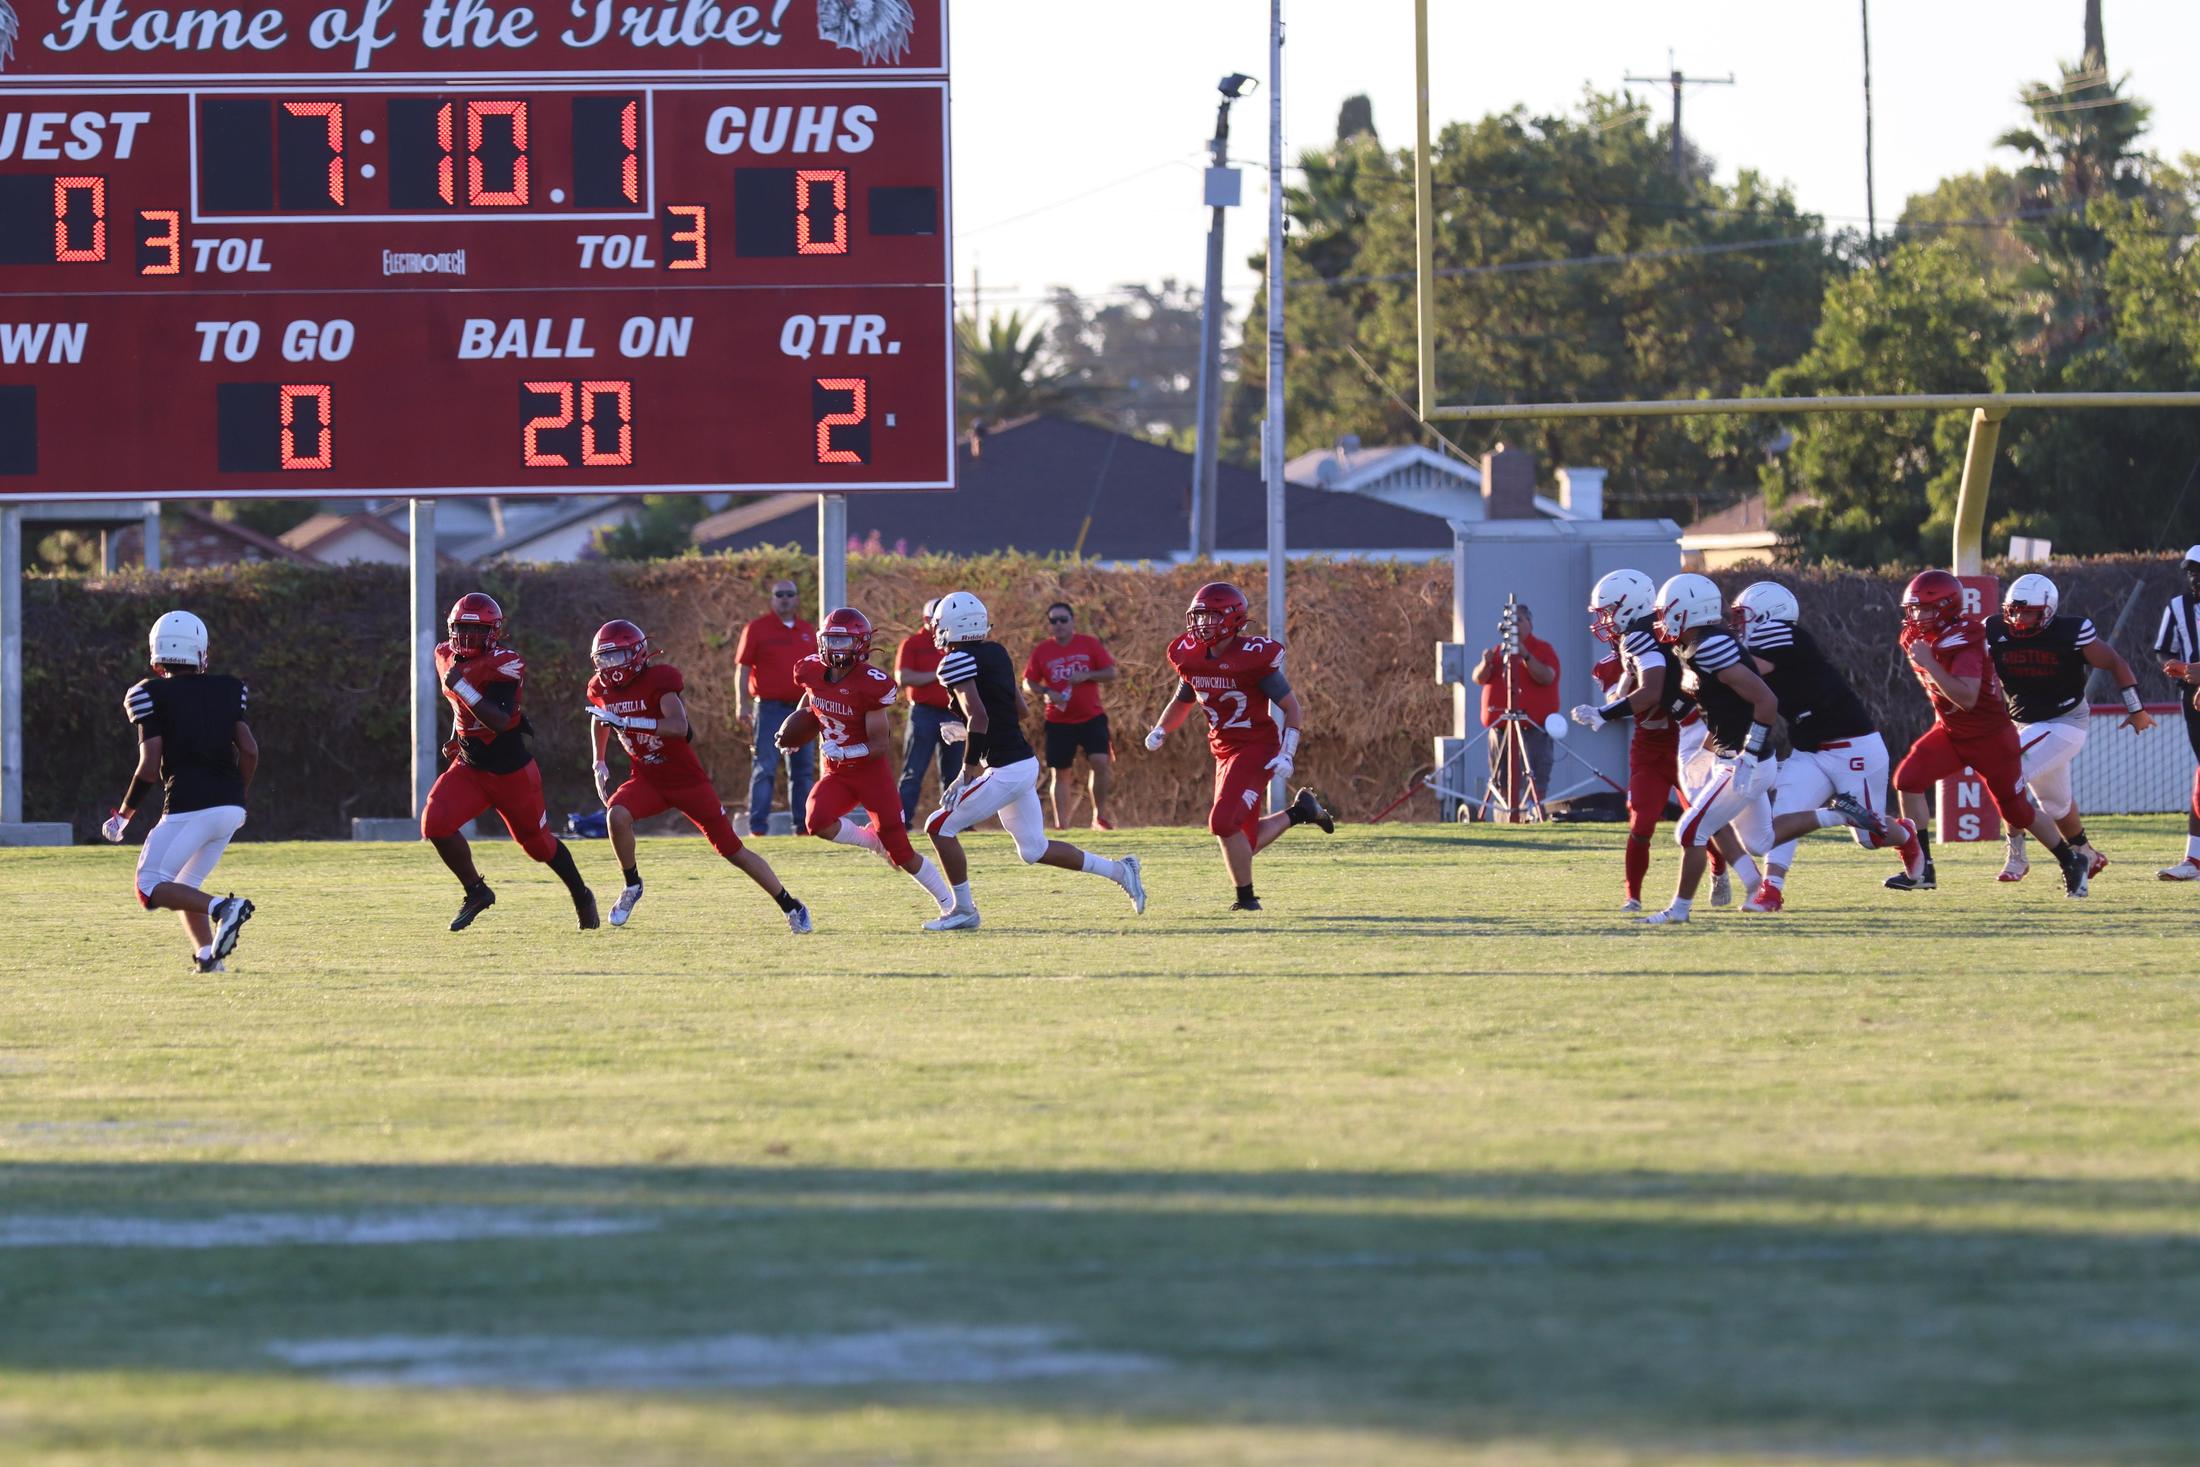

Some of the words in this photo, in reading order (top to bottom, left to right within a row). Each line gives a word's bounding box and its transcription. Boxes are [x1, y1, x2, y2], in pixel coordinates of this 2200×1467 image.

[43, 0, 286, 51] Home
[310, 0, 396, 70] of
[423, 0, 537, 48] the
[561, 0, 790, 48] Tribe!
[705, 105, 877, 154] CUHS
[55, 177, 105, 261] 0
[797, 170, 846, 254] 0
[141, 211, 180, 275] 3
[191, 239, 271, 273] TOL
[576, 235, 655, 269] TOL
[668, 206, 706, 269] 3
[195, 321, 260, 362] TO
[282, 320, 355, 362] GO
[458, 318, 595, 359] BALL
[619, 317, 693, 357] ON
[780, 314, 901, 360] QTR.
[281, 385, 332, 469] 0
[523, 381, 632, 466] 20
[817, 379, 866, 463] 2
[867, 668, 887, 681] 8
[1191, 676, 1237, 689] CHOWCHILLA
[1849, 756, 1865, 771] G
